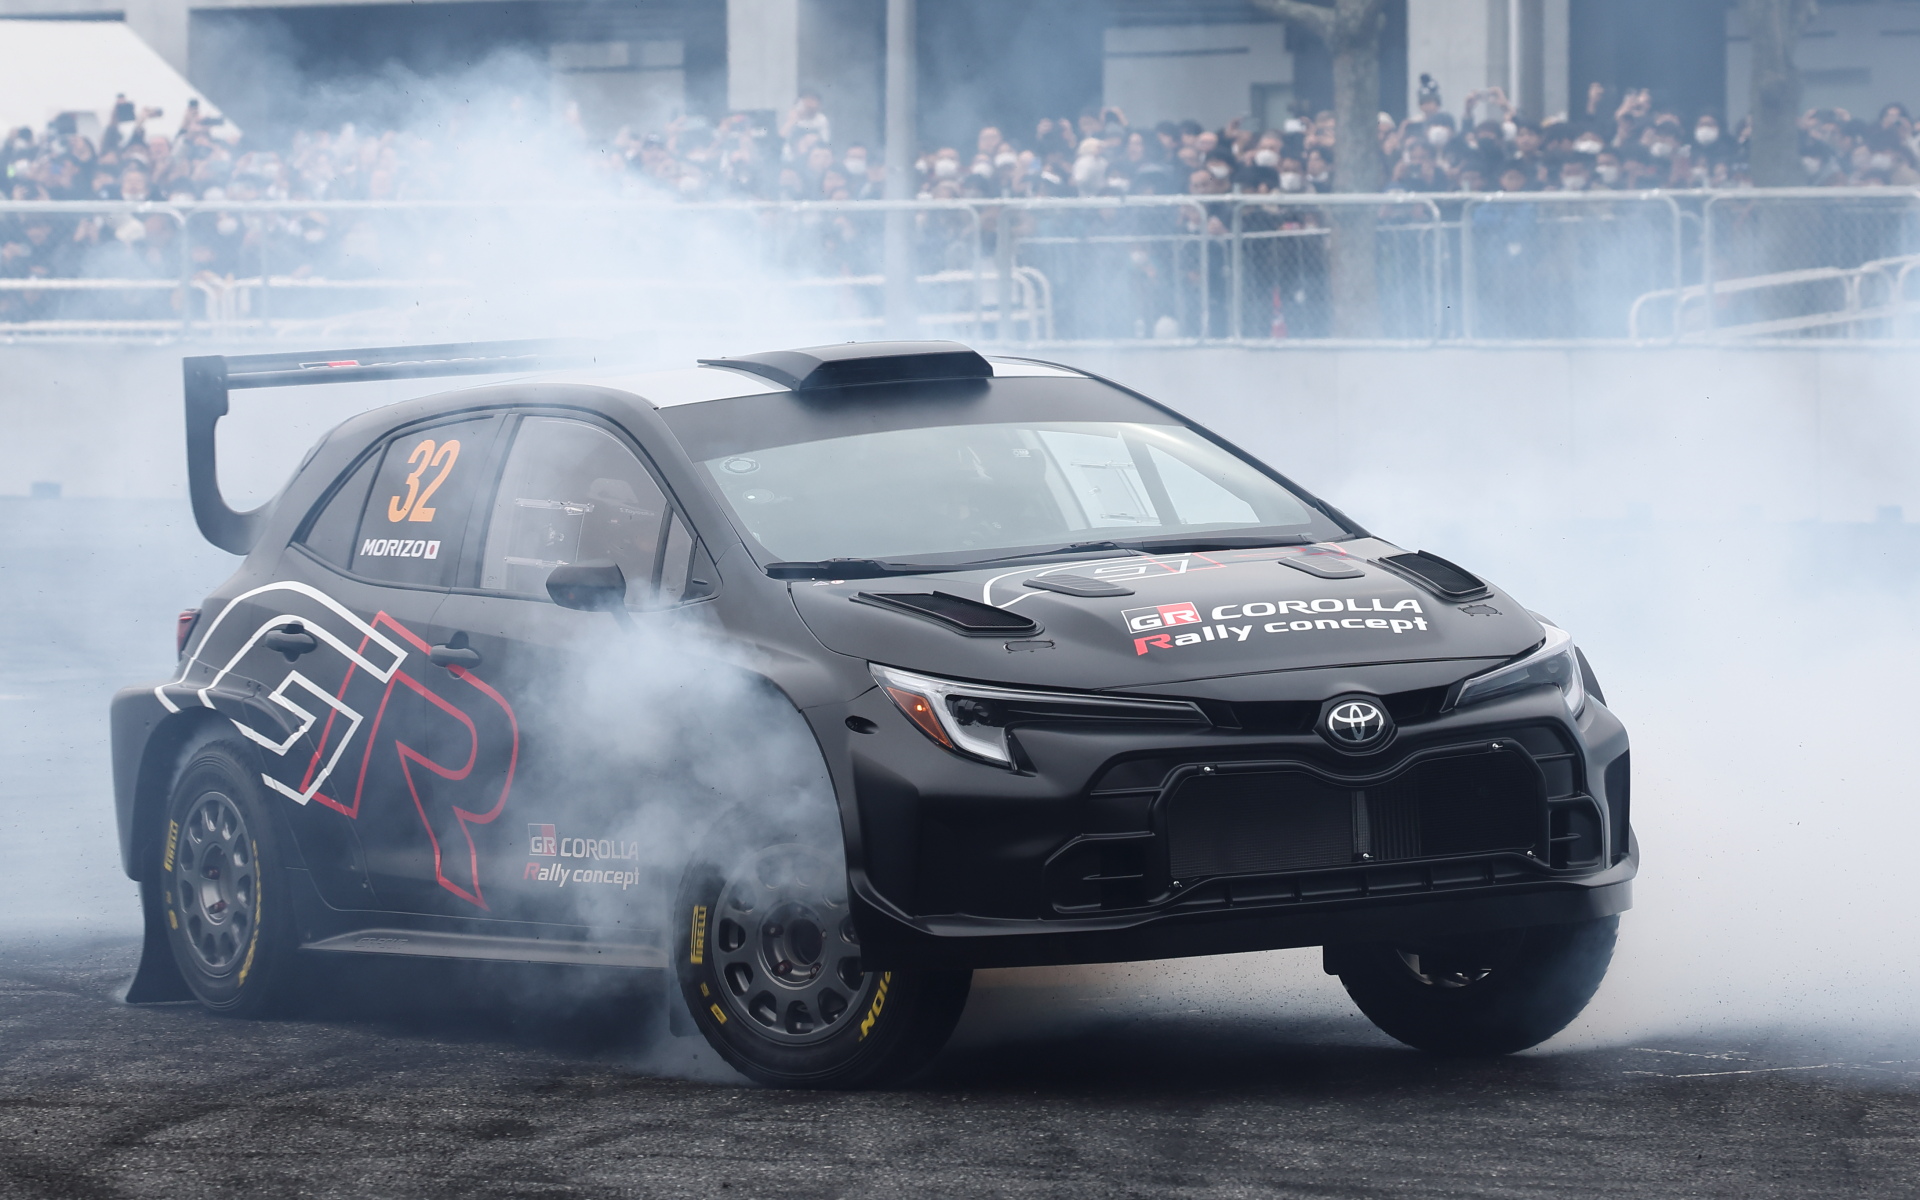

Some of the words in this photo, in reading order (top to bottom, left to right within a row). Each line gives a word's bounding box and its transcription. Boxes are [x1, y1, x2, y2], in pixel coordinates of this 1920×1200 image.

[388, 439, 460, 523] 32
[360, 538, 425, 557] MORIZO
[1129, 607, 1200, 632] GR
[1211, 598, 1424, 621] COROLLA
[1133, 624, 1253, 656] Rally
[1263, 616, 1428, 634] concept
[529, 835, 556, 855] GR
[560, 838, 639, 861] COROLLA
[523, 862, 571, 887] Rally
[572, 867, 640, 890] concept
[690, 904, 707, 964] PIRELLI
